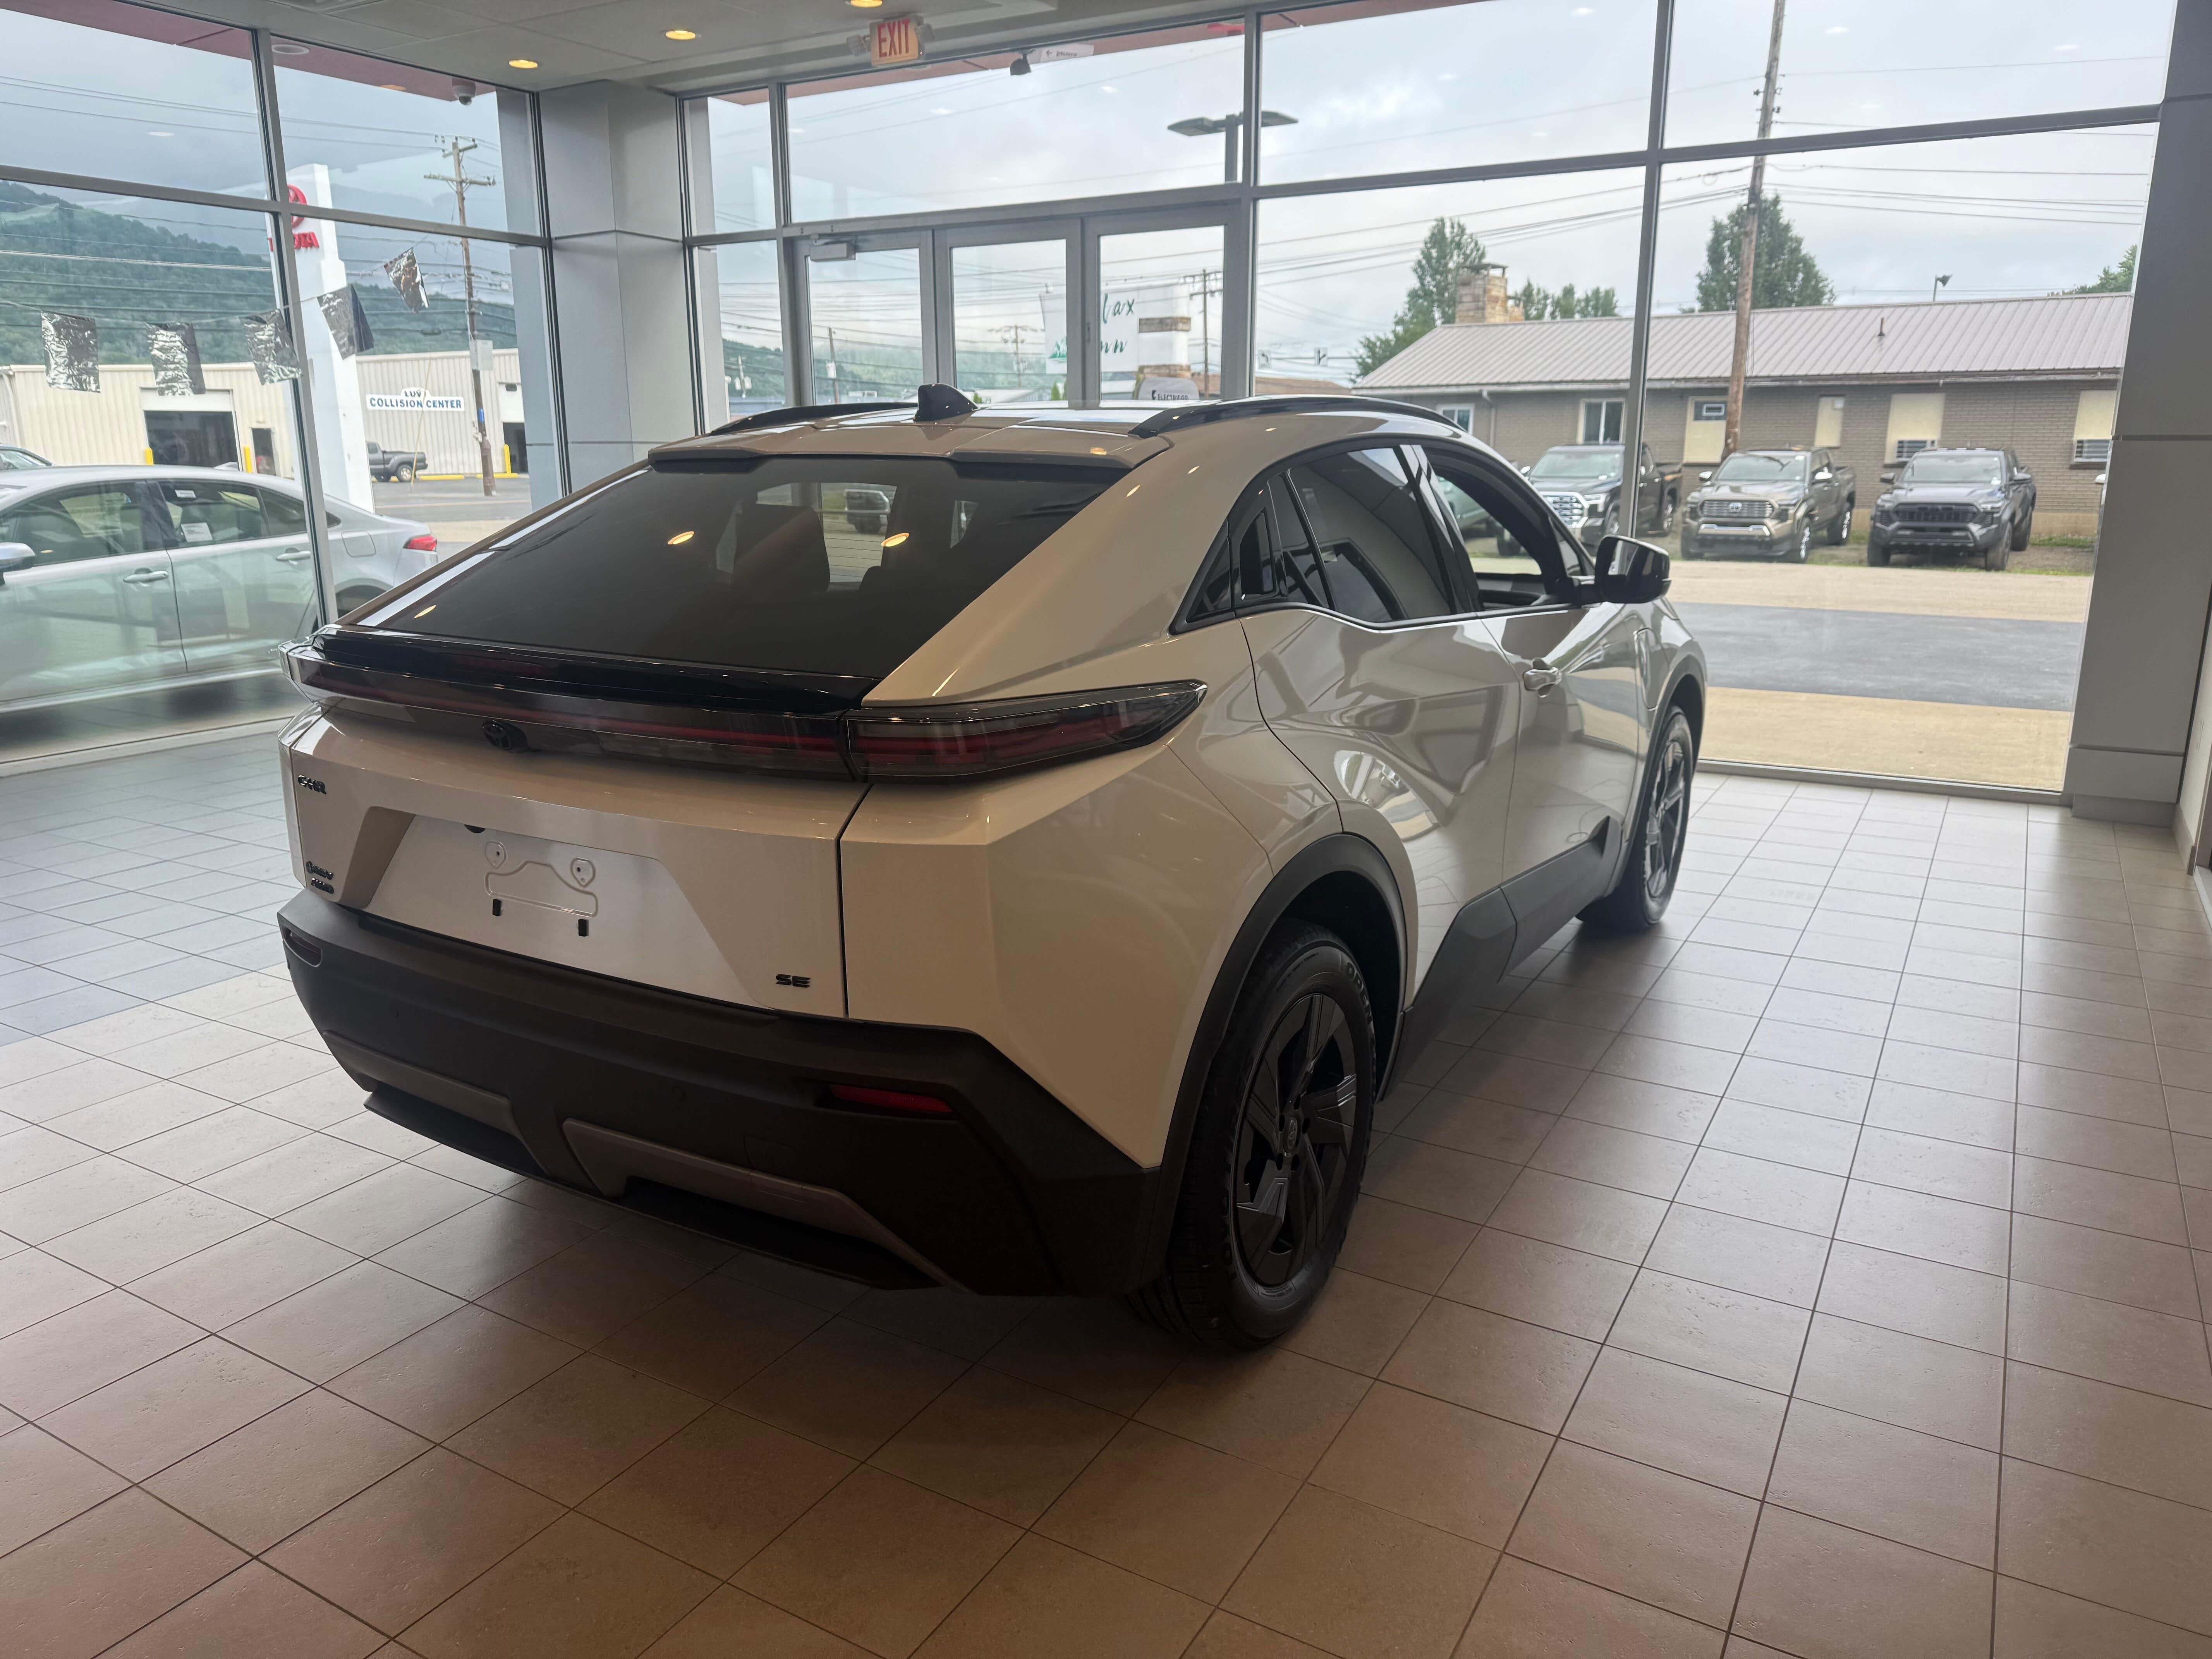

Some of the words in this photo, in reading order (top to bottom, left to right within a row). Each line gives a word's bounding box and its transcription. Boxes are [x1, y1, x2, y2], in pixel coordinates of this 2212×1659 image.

[878, 19, 911, 57] EXIT
[369, 397, 423, 407] COLLISION
[426, 399, 462, 409] CENTER
[775, 974, 811, 988] SE
